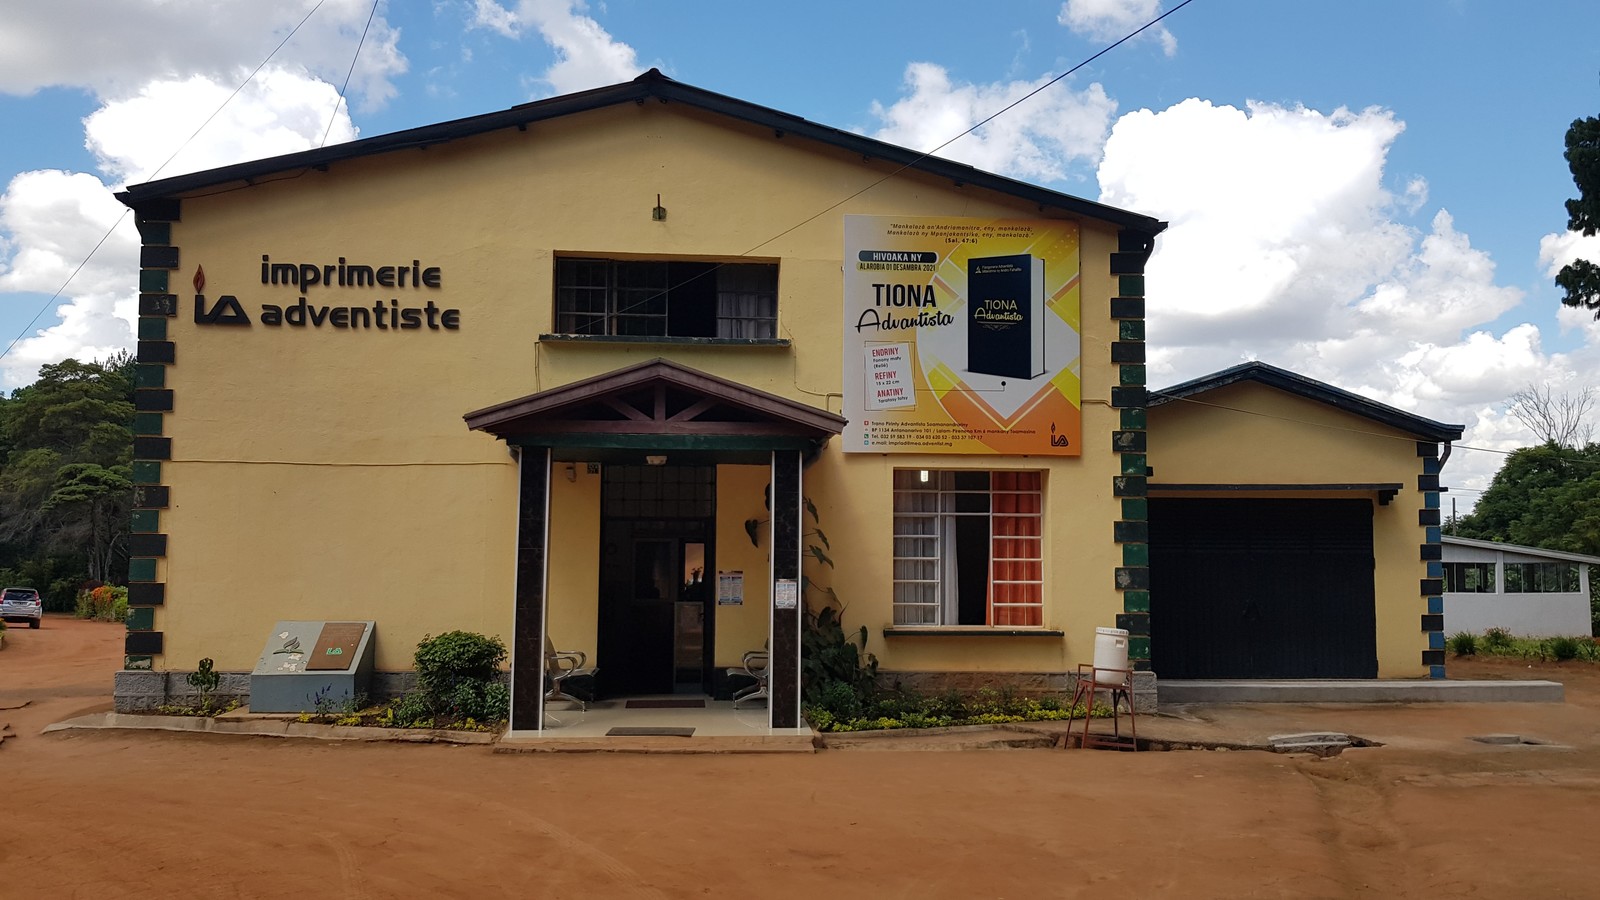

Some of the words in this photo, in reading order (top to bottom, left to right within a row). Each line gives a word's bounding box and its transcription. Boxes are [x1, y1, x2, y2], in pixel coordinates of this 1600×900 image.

[873, 252, 908, 262] HIVOAKA
[911, 253, 922, 262] NY
[860, 263, 885, 271] ALAROBIA
[886, 263, 892, 271] 01
[893, 263, 921, 272] DESAMBRA
[923, 264, 936, 272] 2021
[261, 255, 441, 293] imprimerie
[872, 284, 936, 307] TIONA
[984, 300, 1018, 310] TIONA
[261, 297, 460, 330] adventiste
[974, 307, 1024, 321] Advantista
[854, 308, 954, 333] Advantista
[872, 347, 899, 357] ENDRINY
[875, 370, 897, 380] REFINY
[877, 388, 904, 398] ANATINY
